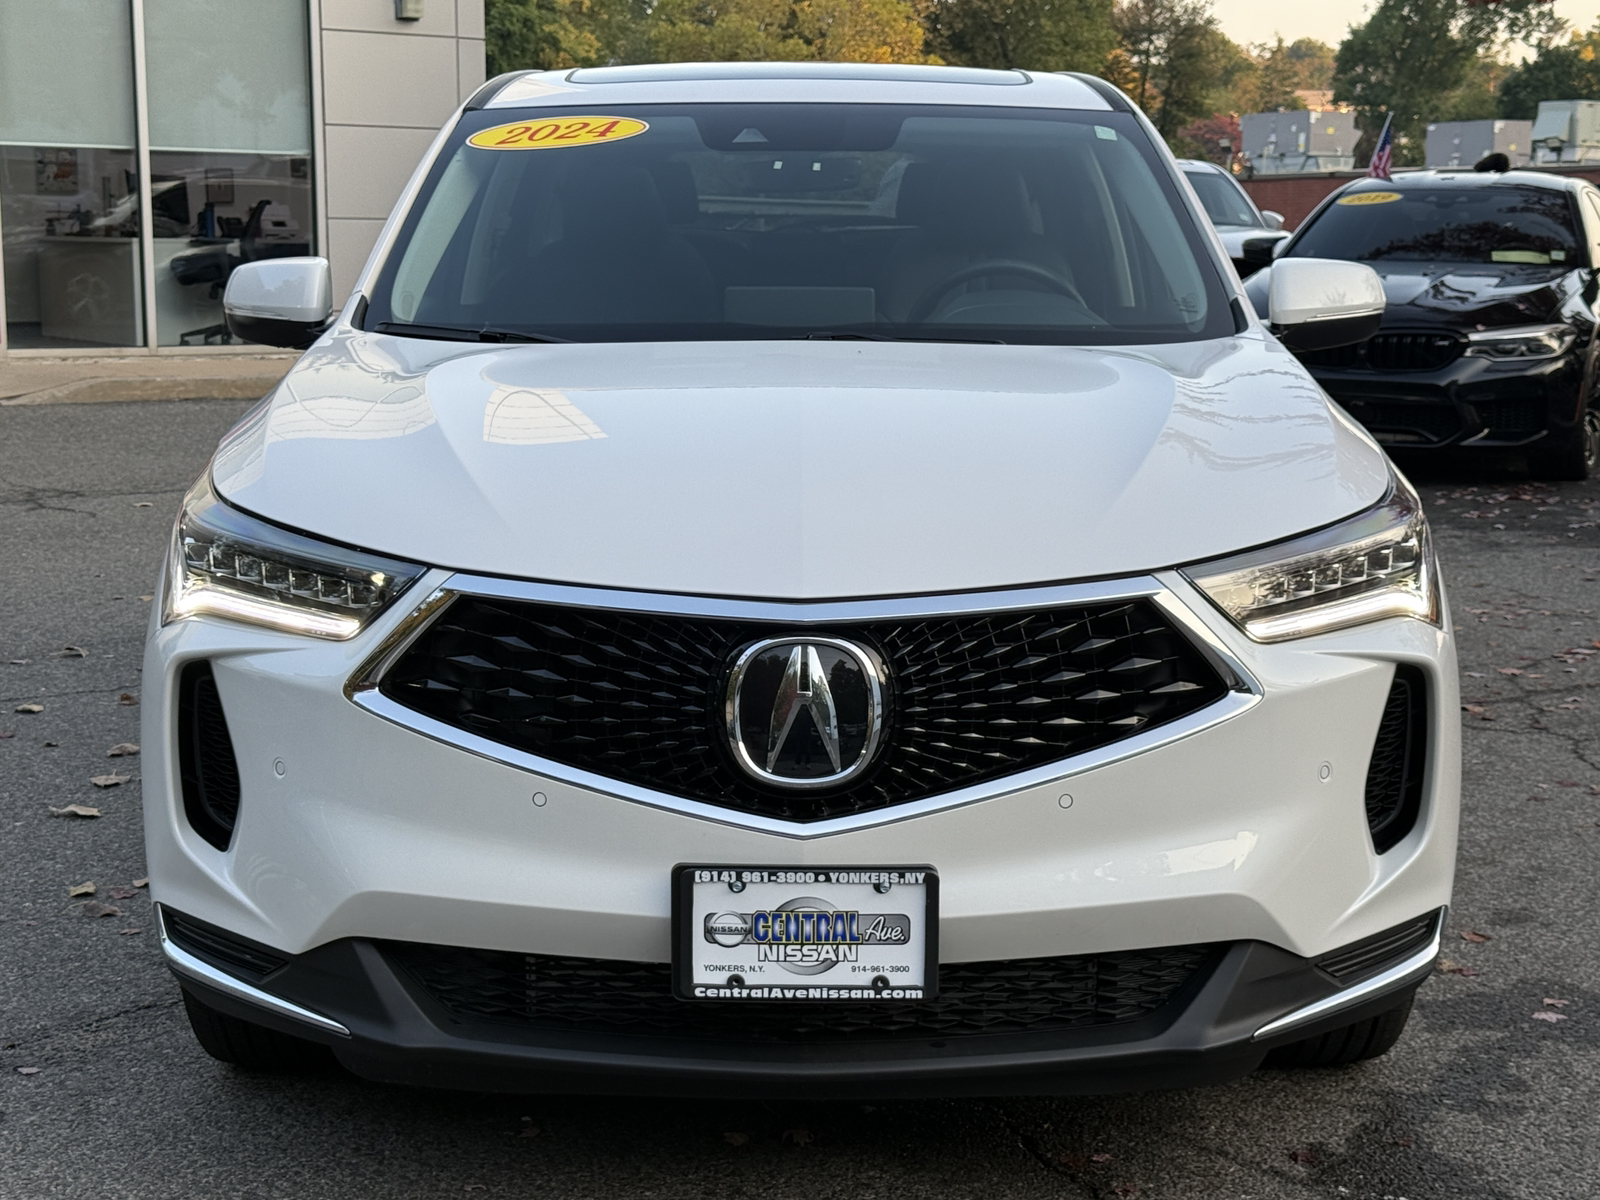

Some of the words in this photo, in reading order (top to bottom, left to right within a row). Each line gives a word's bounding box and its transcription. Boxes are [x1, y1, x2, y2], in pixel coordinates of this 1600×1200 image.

[494, 120, 621, 146] 2024
[741, 871, 815, 884] 961-3900
[709, 925, 748, 933] NISSAN
[752, 910, 863, 944] CENTRAL
[864, 915, 906, 942] Ave.
[758, 944, 858, 962] NISSAN
[703, 964, 748, 974] YONKERS,
[749, 964, 766, 973] N.Y.
[851, 965, 910, 973] 914-961-3900
[694, 987, 923, 999] CentralAveNissan.com
